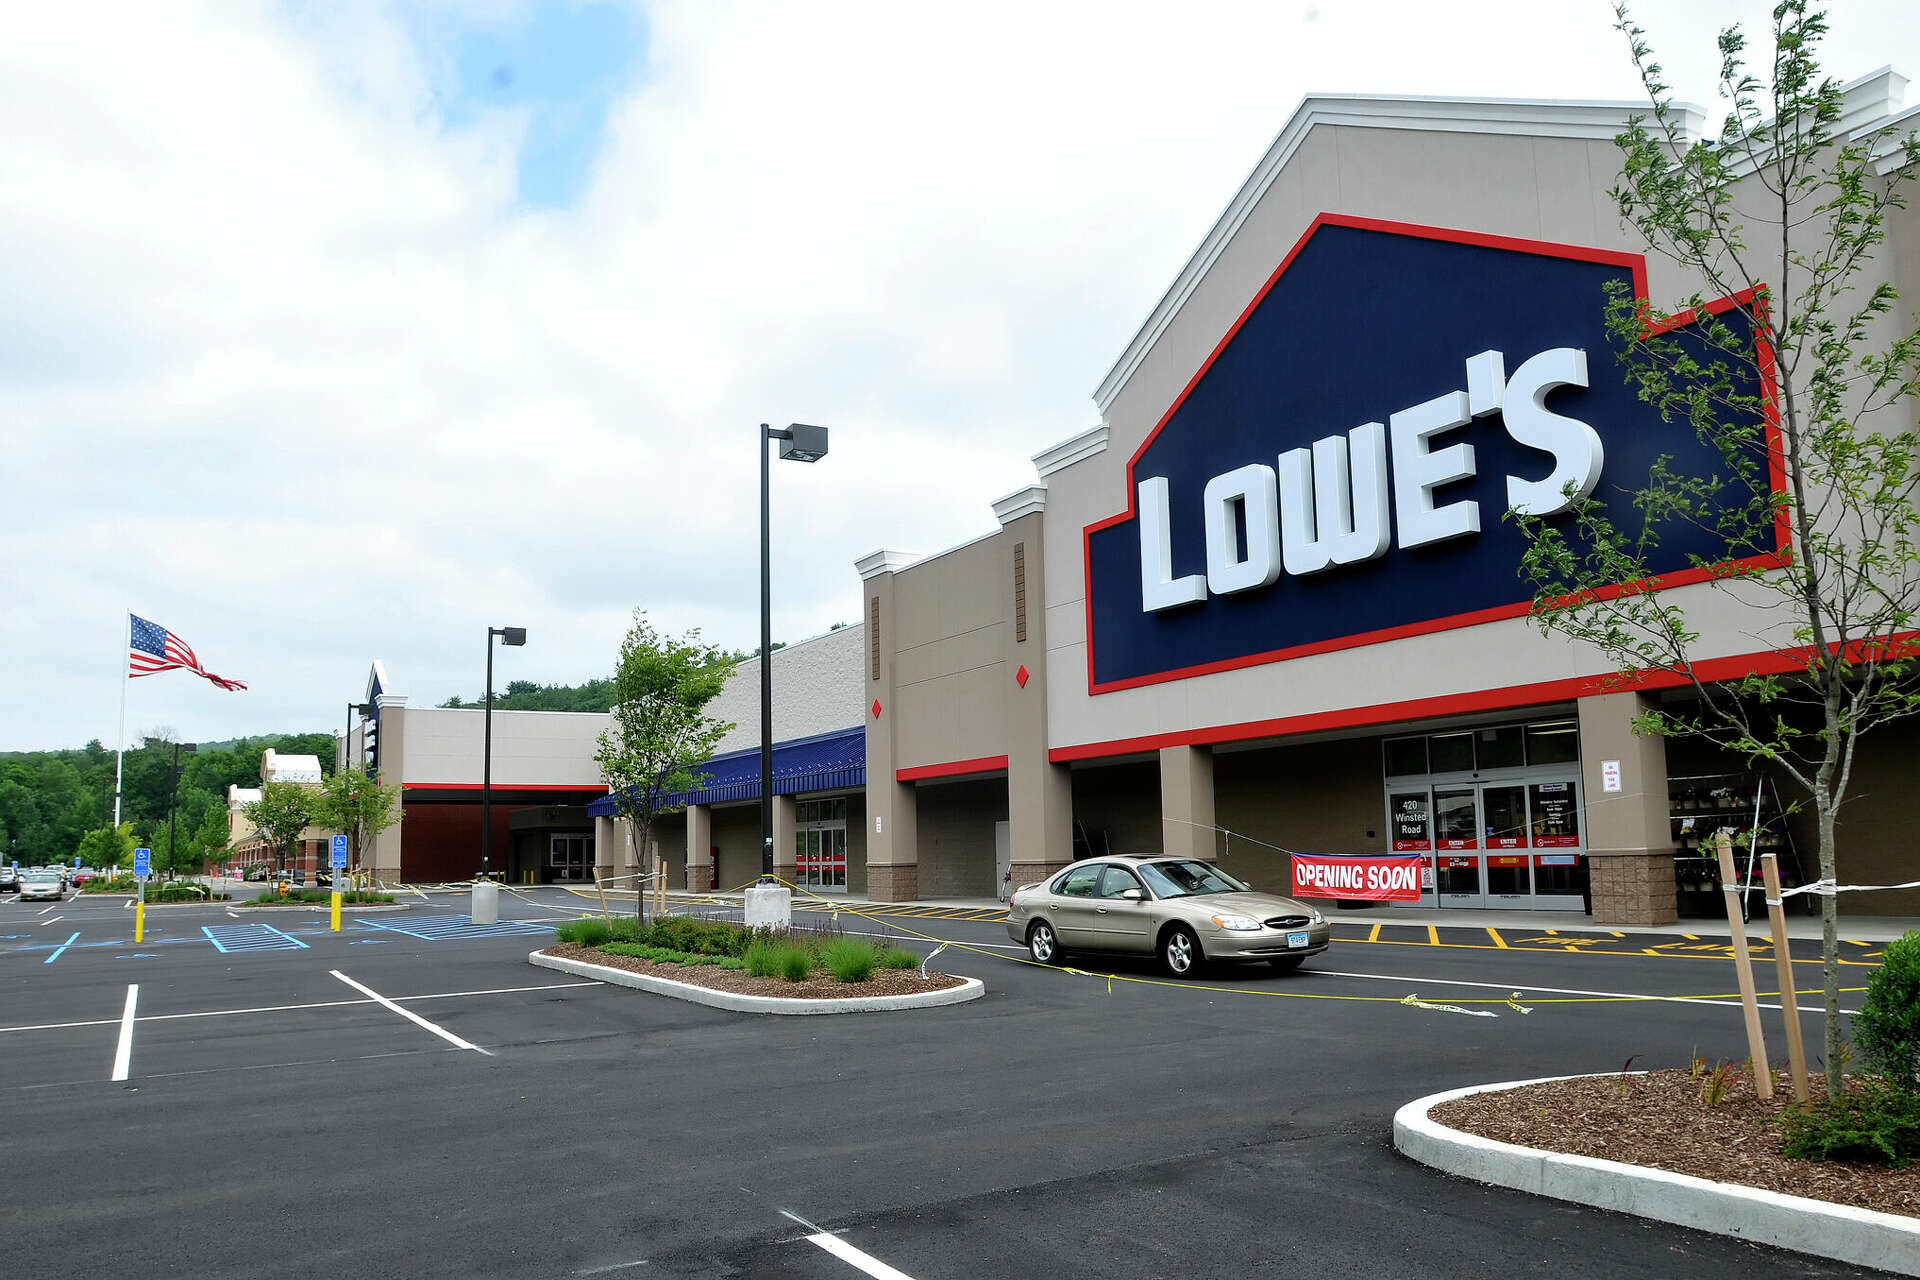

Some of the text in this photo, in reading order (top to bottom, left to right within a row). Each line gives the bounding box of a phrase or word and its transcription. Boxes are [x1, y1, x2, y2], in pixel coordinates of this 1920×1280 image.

[1138, 347, 1605, 614] LOWE'S
[1402, 800, 1418, 810] 420
[1395, 813, 1427, 822] Winsted
[1401, 825, 1422, 834] Road
[1296, 864, 1364, 889] OPENING
[1367, 865, 1417, 890] SOON
